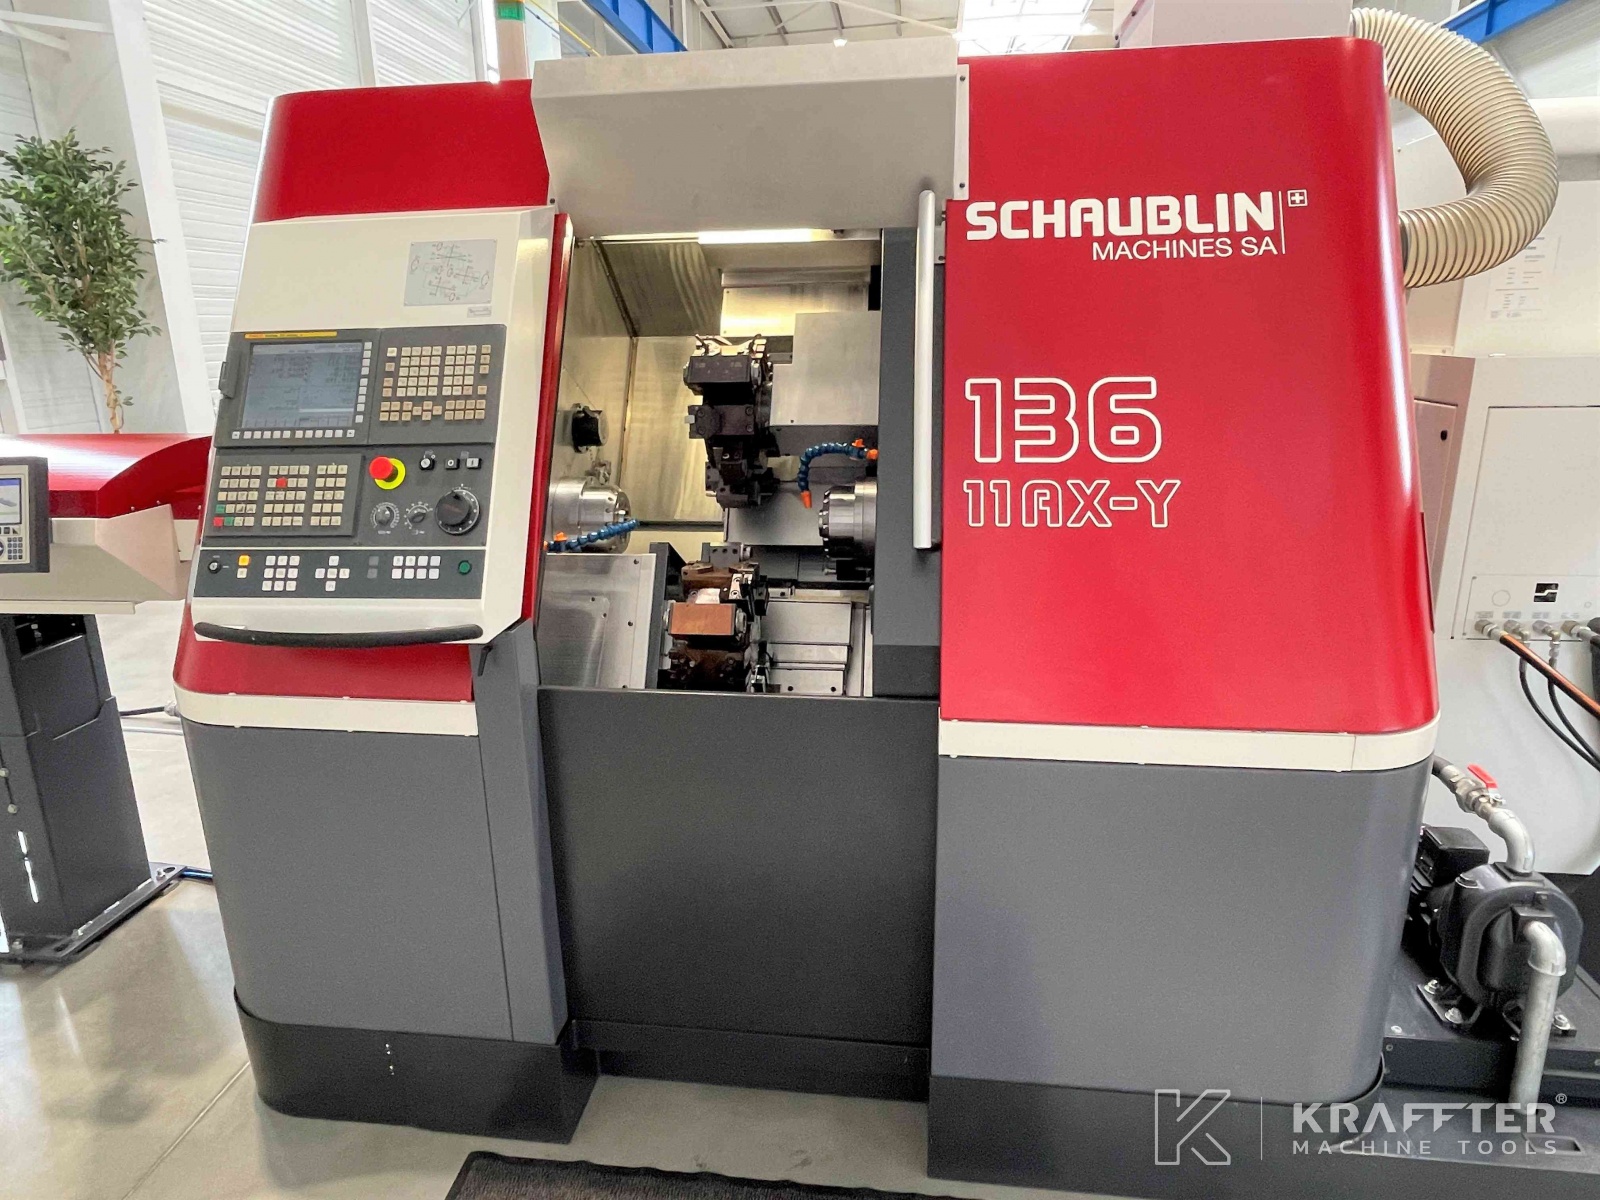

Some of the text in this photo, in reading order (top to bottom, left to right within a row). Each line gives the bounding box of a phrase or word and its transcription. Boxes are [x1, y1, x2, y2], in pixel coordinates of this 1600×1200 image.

[966, 191, 1275, 240] SCHAUBLIN
[1092, 236, 1278, 260] MACHINES SA
[965, 376, 1162, 463] 136
